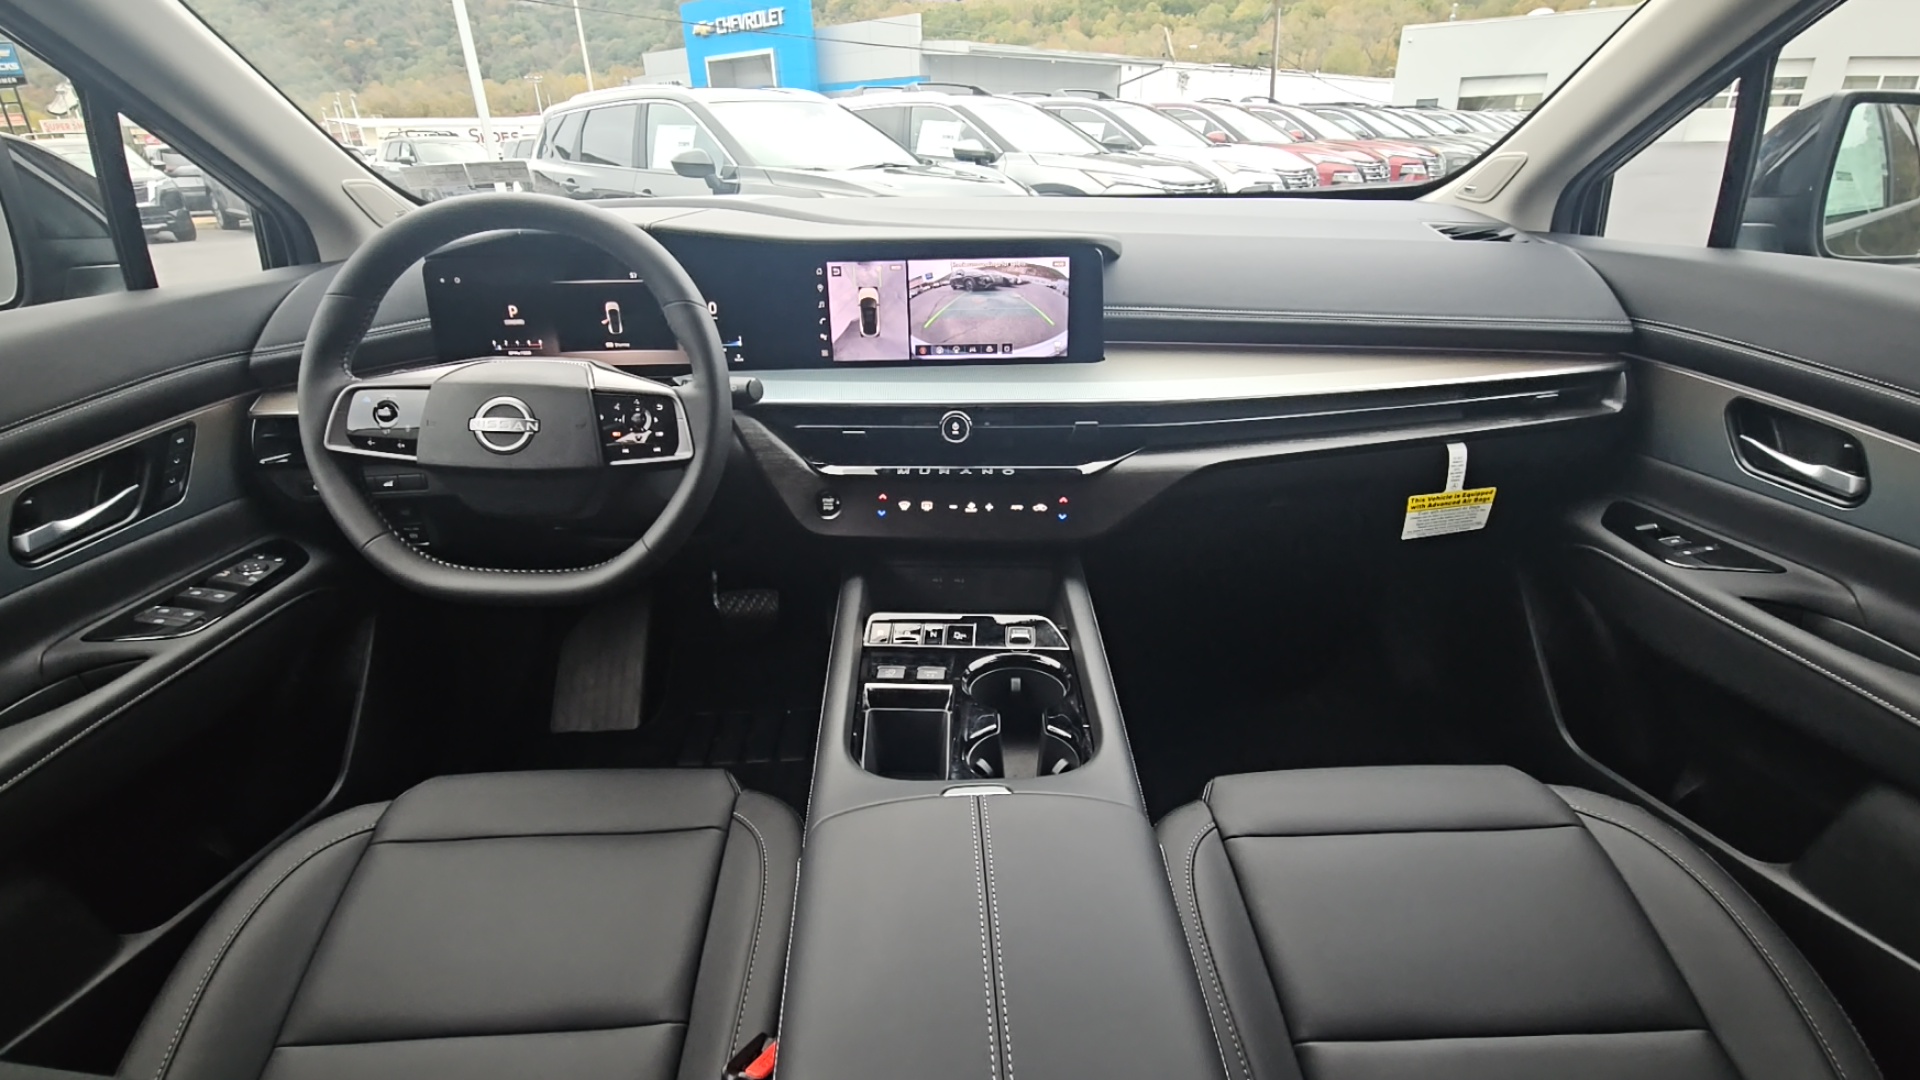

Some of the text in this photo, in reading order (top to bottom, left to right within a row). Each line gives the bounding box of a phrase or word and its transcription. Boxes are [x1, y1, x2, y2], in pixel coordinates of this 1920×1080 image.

[715, 7, 785, 34] CHEVROLET
[507, 304, 519, 318] P
[471, 419, 538, 431] NISSAN
[896, 467, 1015, 475] MURANO
[1428, 494, 1453, 502] Vehicle
[1462, 489, 1494, 498] Equipped
[1427, 500, 1461, 508] Advanced
[929, 630, 938, 638] N
